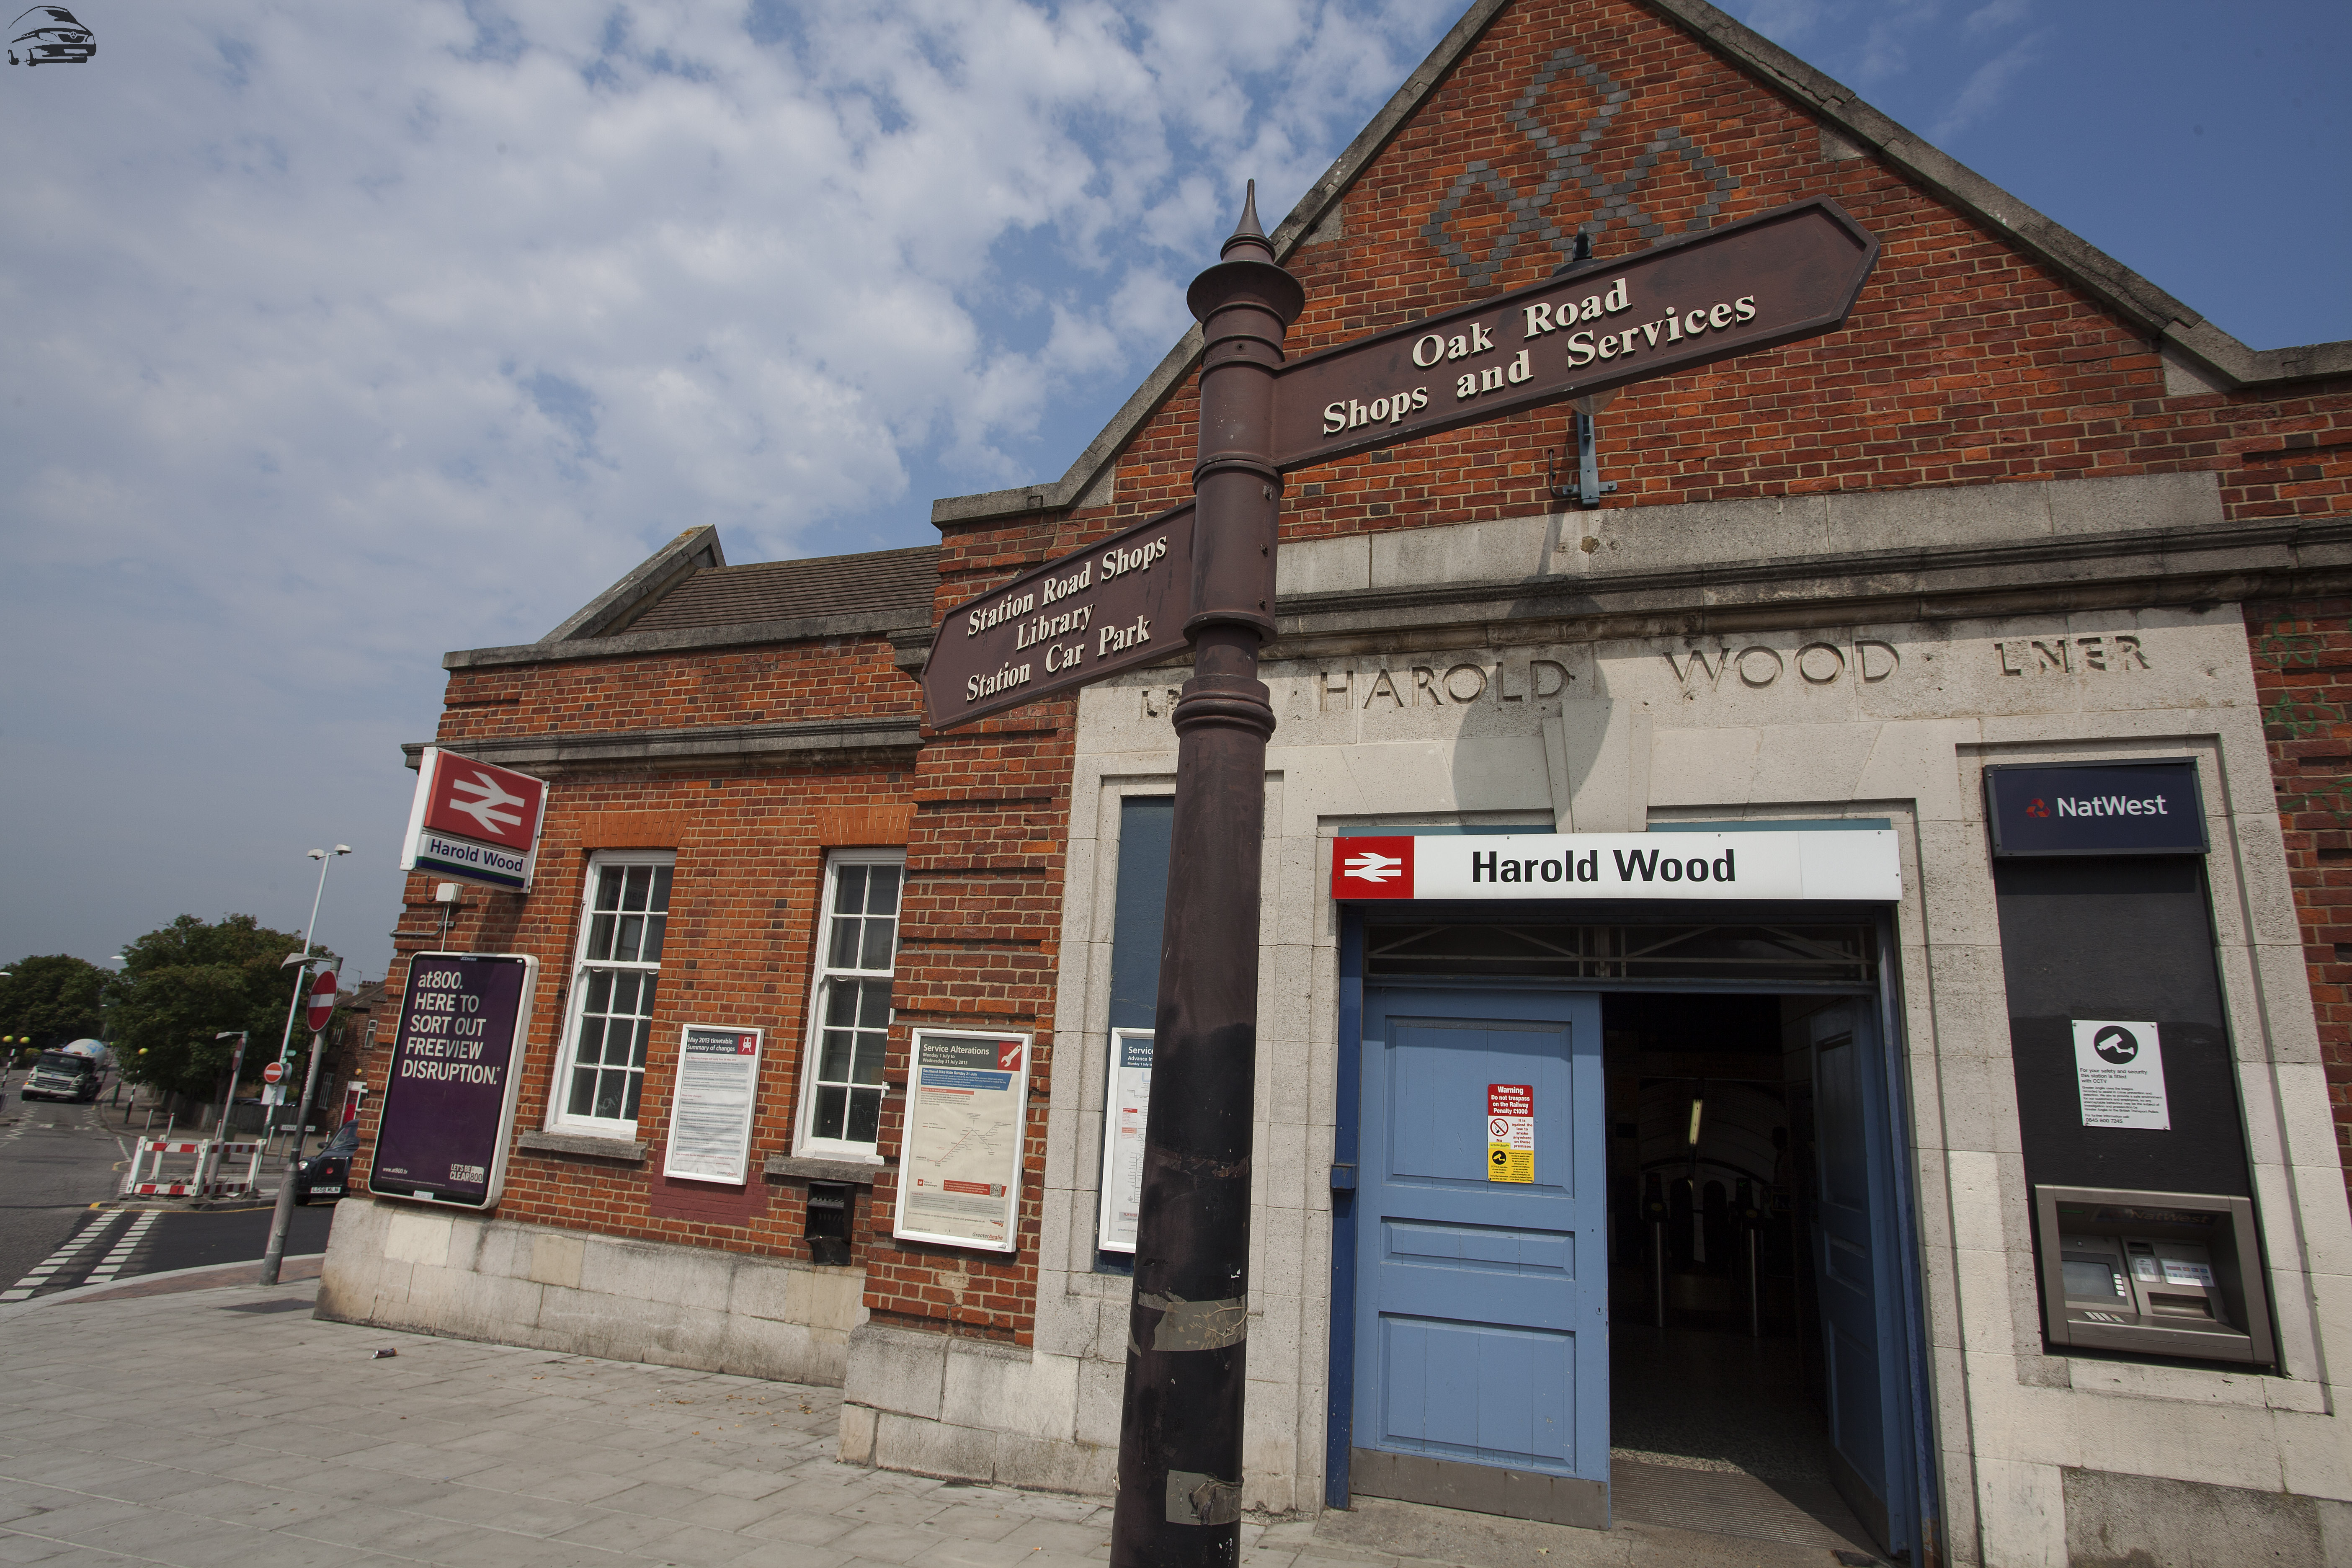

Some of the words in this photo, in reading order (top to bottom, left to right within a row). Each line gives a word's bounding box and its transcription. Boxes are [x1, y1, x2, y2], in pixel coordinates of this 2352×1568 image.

[1413, 323, 1495, 367] Oak
[1524, 278, 1631, 338] Road
[1323, 387, 1428, 435] Shops
[1457, 350, 1533, 398] and
[1568, 295, 1756, 368] Services
[968, 593, 1034, 636] Station
[1042, 561, 1091, 605] Road
[1101, 536, 1167, 581] Shops
[1016, 604, 1096, 650] Library
[966, 663, 1030, 701] Station
[1046, 642, 1085, 673] Car
[1097, 615, 1151, 656] Park
[1320, 660, 1570, 712] HAROLD
[1663, 640, 1900, 693] WOOD
[1994, 635, 2151, 676] LNER
[2057, 795, 2168, 817] NatWest
[430, 839, 479, 862] Harold
[484, 851, 524, 872] Wood
[1473, 850, 1598, 882] Harold
[1613, 849, 1735, 882] Wood
[418, 971, 463, 989] at800.
[415, 992, 456, 1011] HERE
[460, 995, 479, 1013] TO
[410, 1014, 451, 1034] SORT
[455, 1017, 486, 1036] OUT
[406, 1037, 483, 1059] FREEVIEW
[923, 1044, 949, 1052] Service
[950, 1046, 990, 1055] Alterations
[1498, 1086, 1523, 1095] Warning
[450, 1171, 470, 1181] CLEAR
[470, 1173, 482, 1182] 800
[2131, 1209, 2210, 1224] NatWest
